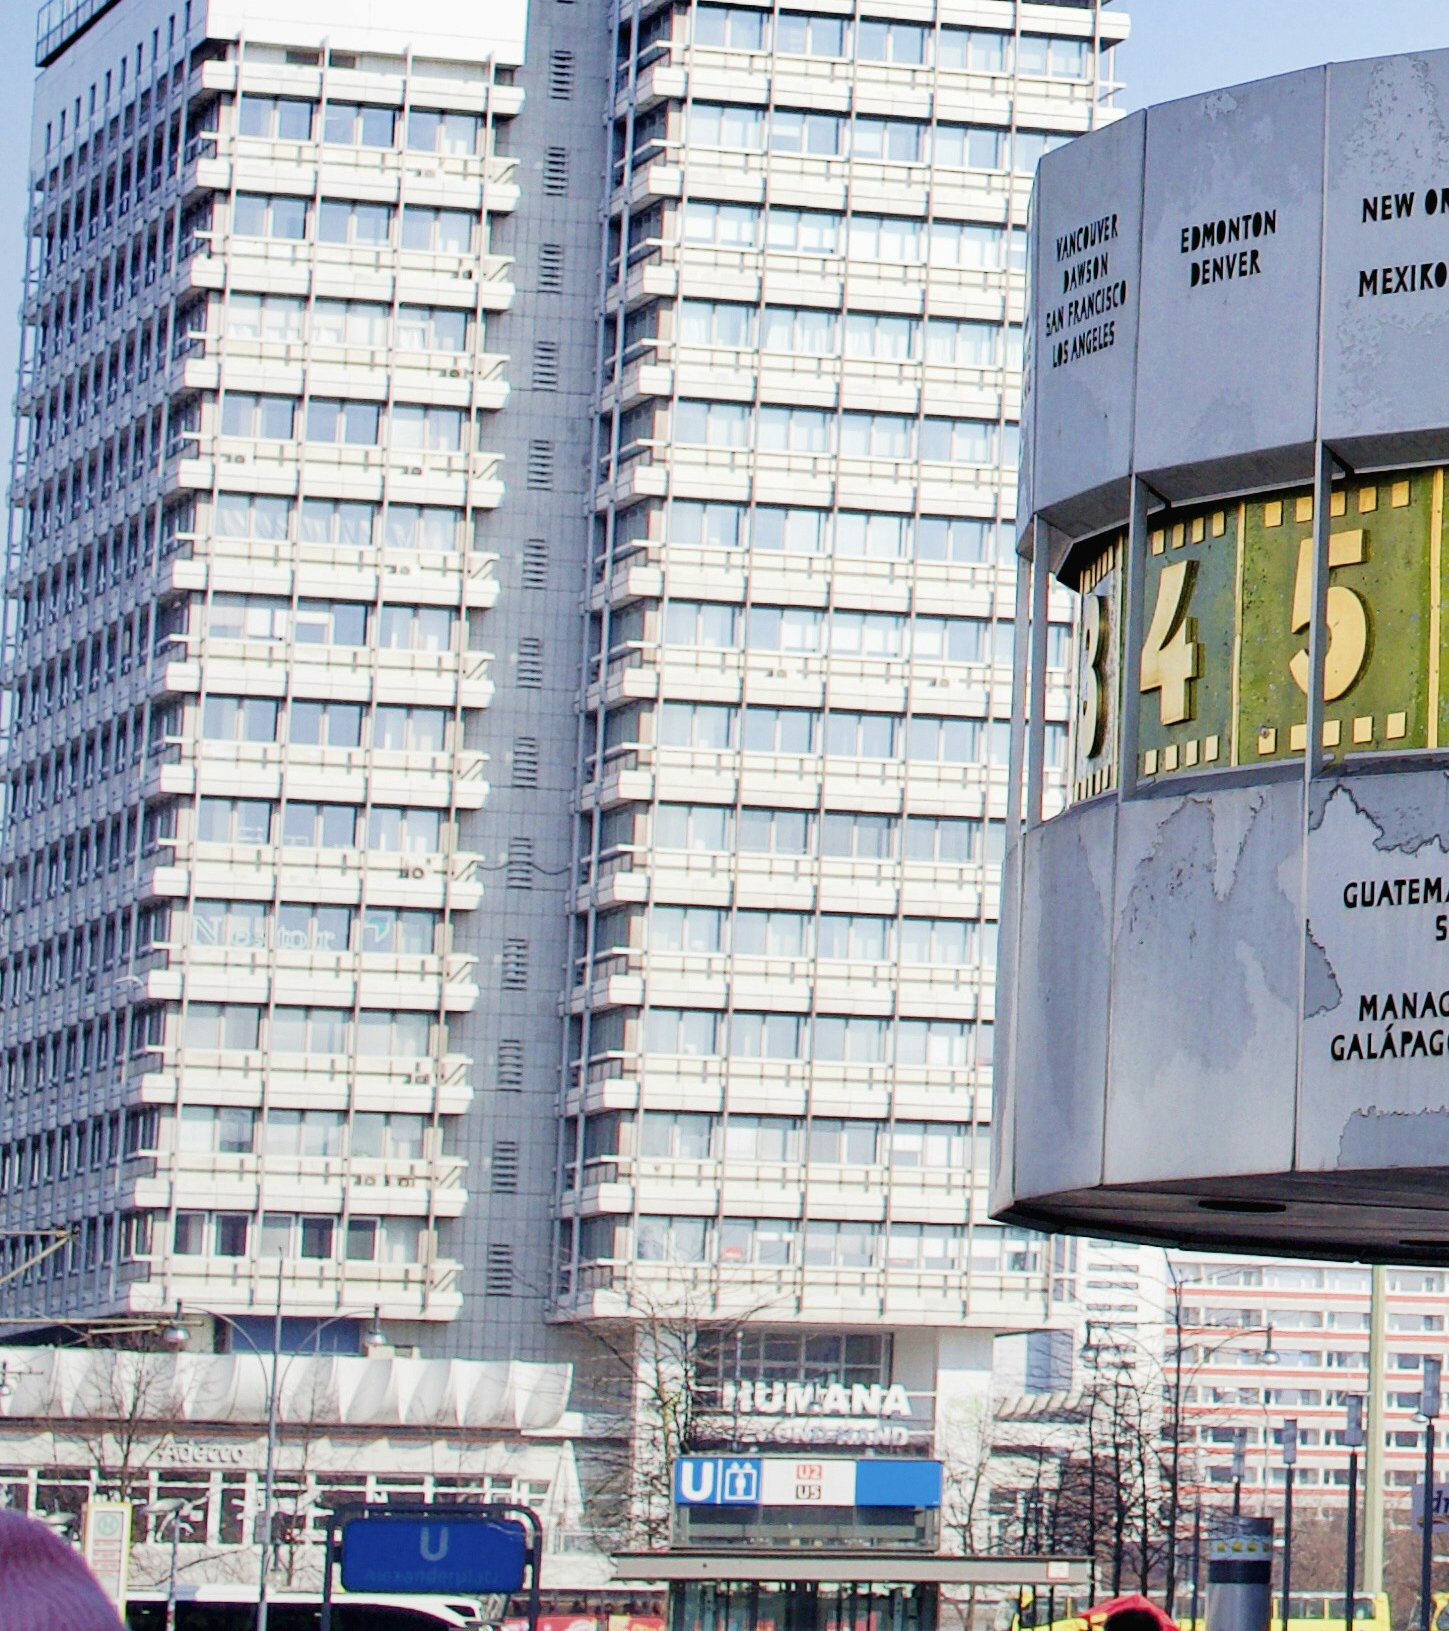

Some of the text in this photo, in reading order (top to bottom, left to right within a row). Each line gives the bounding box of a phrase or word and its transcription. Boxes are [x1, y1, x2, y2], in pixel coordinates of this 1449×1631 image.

[1362, 191, 1415, 223] NEW
[1056, 213, 1118, 261] VANCOUVER
[1180, 209, 1277, 253] EDMONTON
[1063, 255, 1108, 294] DAWSON
[1190, 250, 1261, 288] DENVER
[1045, 282, 1127, 337] SAN FRANCISCO
[1052, 321, 1115, 368] LOS ANGELES
[1139, 559, 1201, 726] 4
[1288, 528, 1370, 703] 5
[722, 1381, 912, 1417] HUMANA
[680, 1462, 714, 1501] U
[796, 1465, 822, 1480] U2
[796, 1485, 820, 1500] U5
[420, 1526, 449, 1562] U
